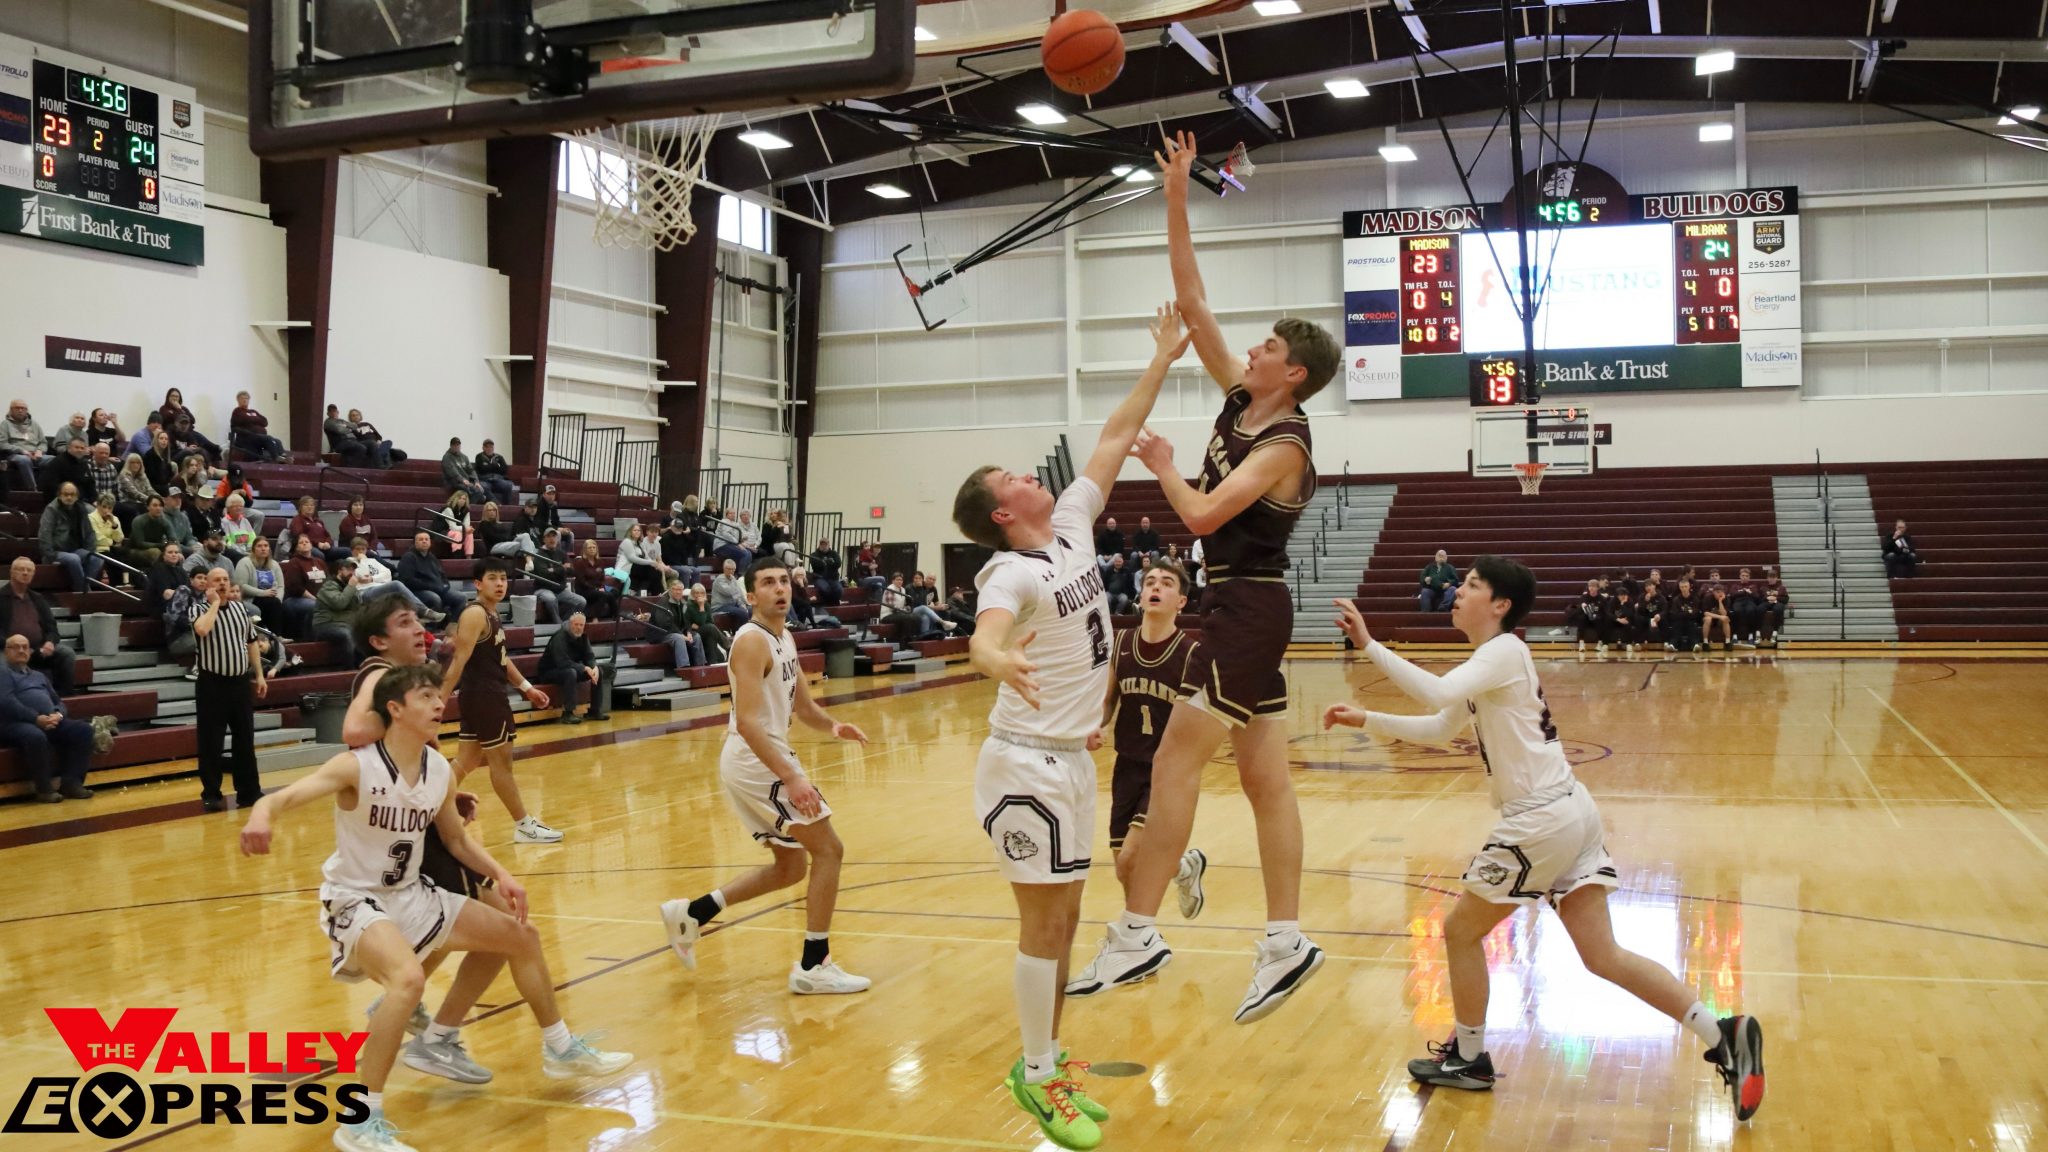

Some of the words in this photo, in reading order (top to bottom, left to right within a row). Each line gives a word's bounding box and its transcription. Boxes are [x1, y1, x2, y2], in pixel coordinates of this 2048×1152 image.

[0, 64, 28, 78] TROLLO
[82, 77, 127, 112] 4:56
[39, 96, 67, 115] HOME
[43, 114, 72, 146] 23
[87, 116, 110, 129] PERIOD
[125, 119, 154, 137] GUEST
[93, 130, 104, 151] 2
[35, 143, 57, 156] FOULS
[130, 136, 155, 165] 24
[42, 155, 55, 177] 0
[78, 153, 103, 167] PLAYER
[104, 157, 120, 170] FOUL
[138, 167, 158, 179] FOULS
[35, 179, 58, 192] SCORE
[144, 178, 156, 200] 0
[87, 190, 110, 203] MATCH
[1581, 197, 1607, 205] PERIOD
[1643, 190, 1785, 219] BULLDOGS
[138, 201, 158, 213] SCORE
[1539, 200, 1581, 222] 4:56
[1590, 206, 1600, 222] 2
[40, 205, 77, 232] First
[80, 213, 120, 240] Bank
[122, 225, 133, 242] &
[134, 223, 171, 250] Trust
[1360, 207, 1484, 235] MADISON
[1685, 224, 1727, 237] MILBANK
[1410, 237, 1449, 250] MADISON
[1756, 237, 1782, 245] GUARD
[1704, 240, 1730, 260] 24
[1347, 257, 1396, 265] PROSTROLLO
[1413, 254, 1438, 274] 23
[1748, 259, 1791, 268] 256-5287
[1417, 281, 1428, 289] FLS
[1684, 280, 1697, 296] 4
[1718, 278, 1731, 297] 0
[1413, 291, 1426, 309] 0
[1441, 291, 1453, 306] 4
[1754, 294, 1796, 303] Heartland
[1754, 302, 1780, 311] Energy
[1681, 307, 1694, 315] PLY
[1701, 306, 1714, 314] FLS
[1721, 305, 1734, 313] PTS
[1689, 317, 1699, 331] 5
[1729, 315, 1739, 329] 7
[1408, 328, 1423, 342] 10
[1426, 327, 1437, 342] 0
[1449, 326, 1460, 341] 2
[65, 348, 102, 363] BULLDOG
[103, 352, 125, 365] FANS
[1745, 349, 1797, 362] Madison
[1482, 361, 1515, 376] 4:56
[1544, 361, 1597, 382] Bank
[1600, 366, 1614, 380] &
[1616, 359, 1669, 379] Trust
[1489, 376, 1512, 402] 13
[1568, 430, 1604, 440] STUDETS
[1086, 607, 1109, 670] 2
[1140, 704, 1153, 735] 1
[381, 839, 414, 887] 3
